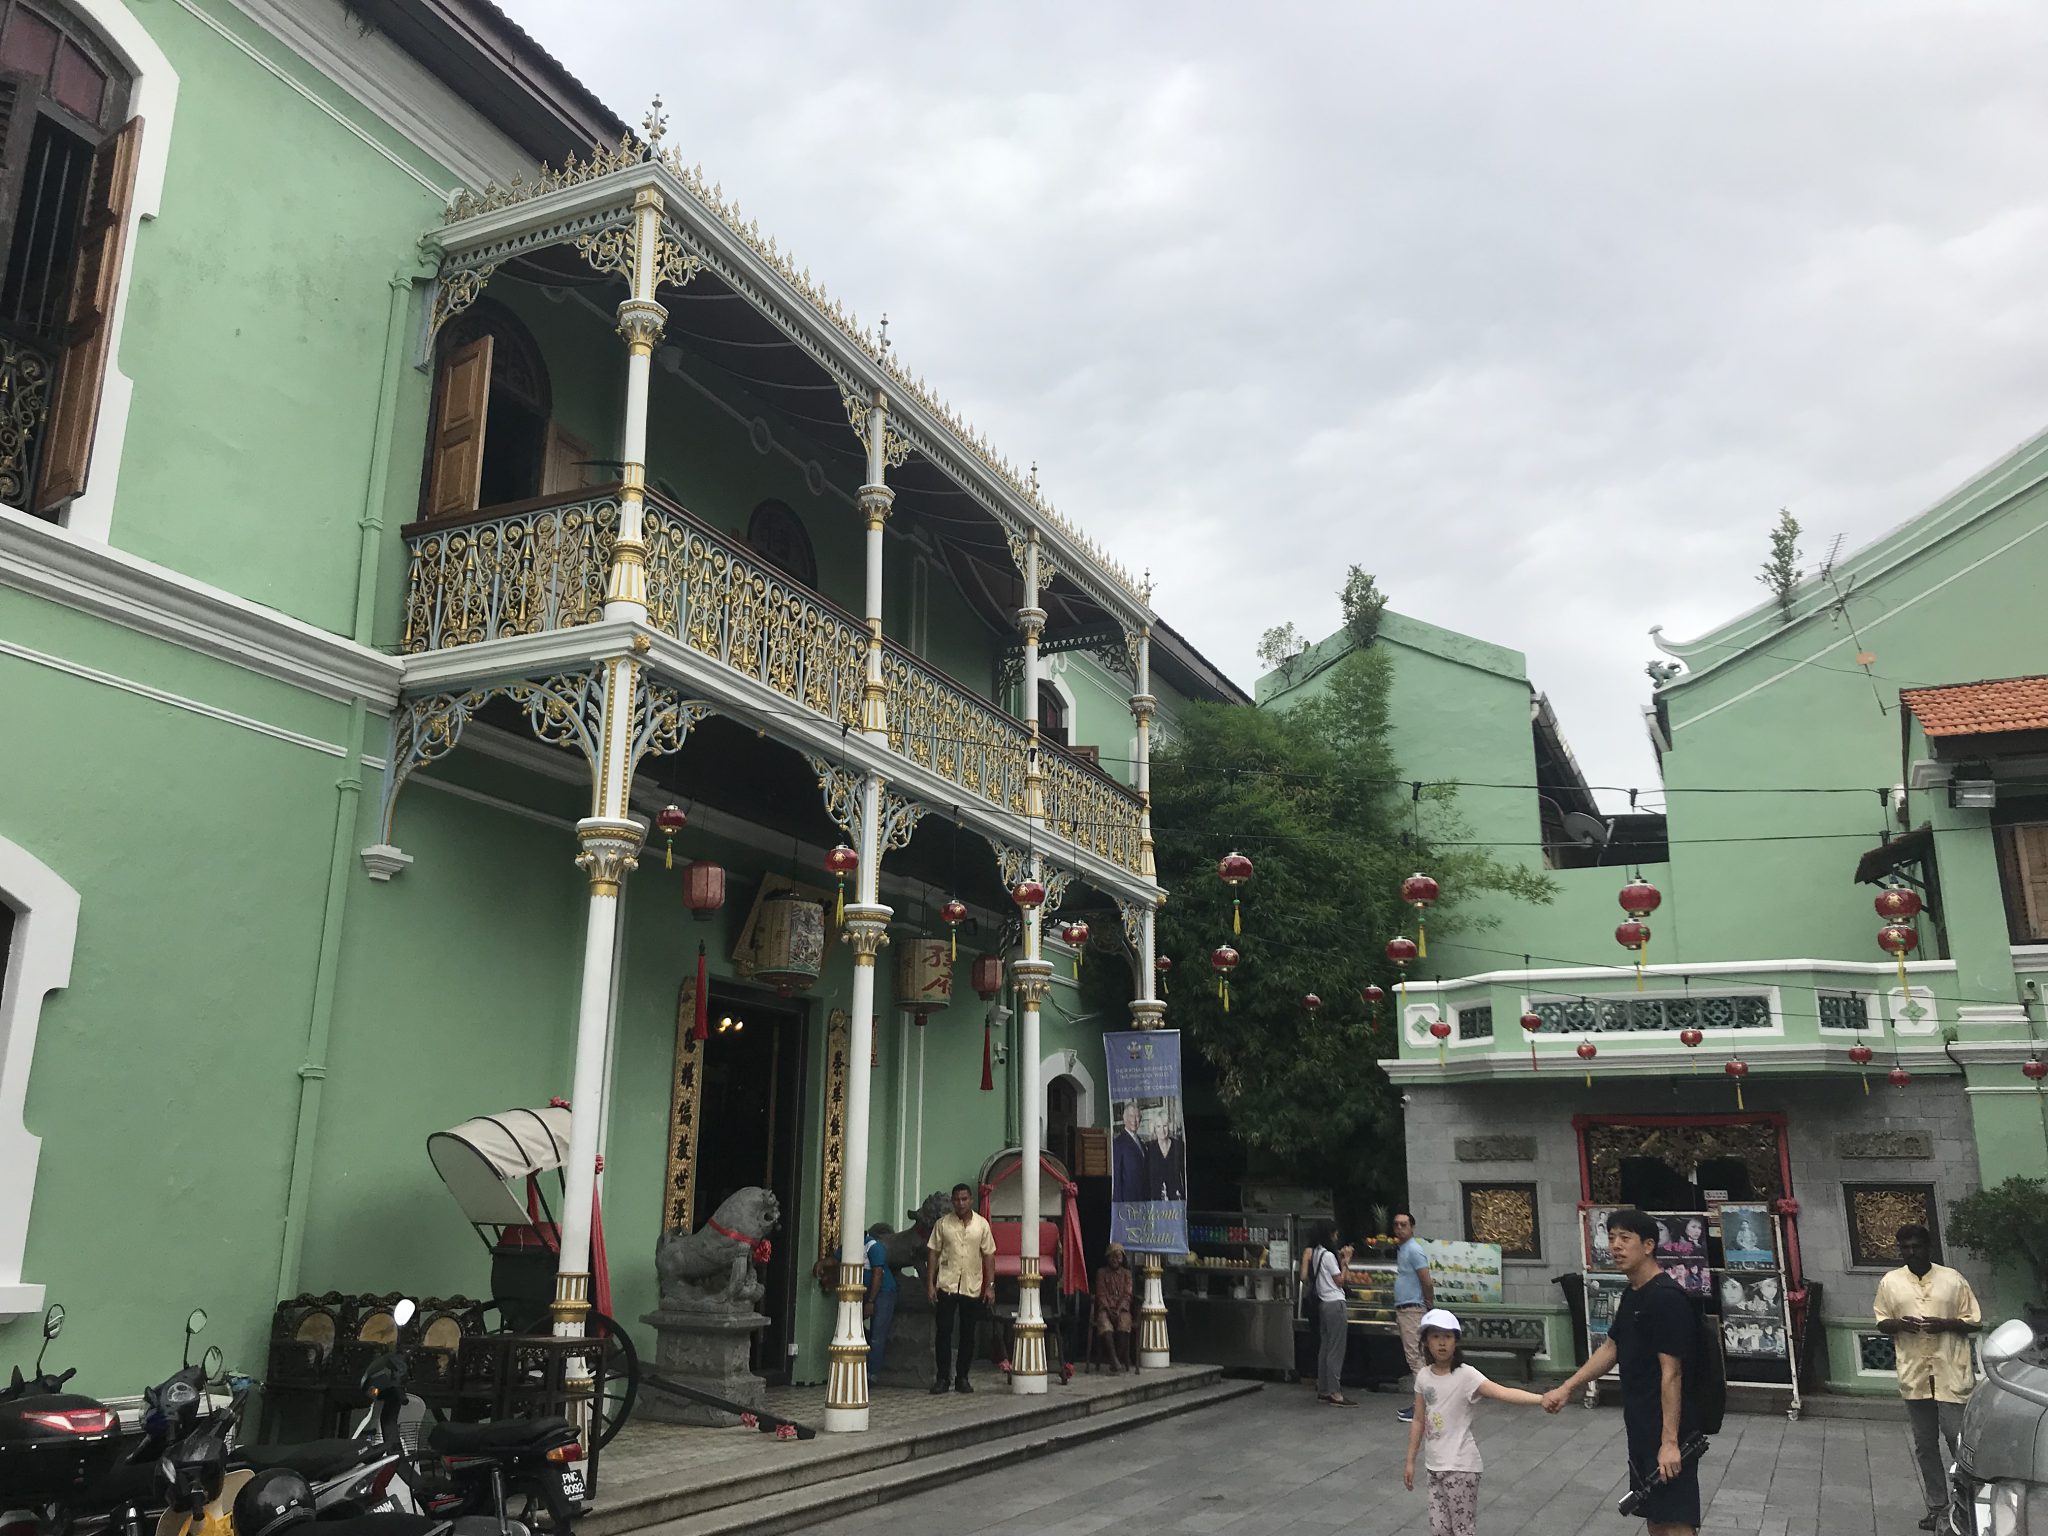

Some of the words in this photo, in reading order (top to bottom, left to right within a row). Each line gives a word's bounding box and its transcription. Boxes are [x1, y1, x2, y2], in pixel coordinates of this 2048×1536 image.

[1118, 1203, 1183, 1222] Welcome
[1125, 1227, 1176, 1246] Penang
[563, 1482, 586, 1496] 8092
